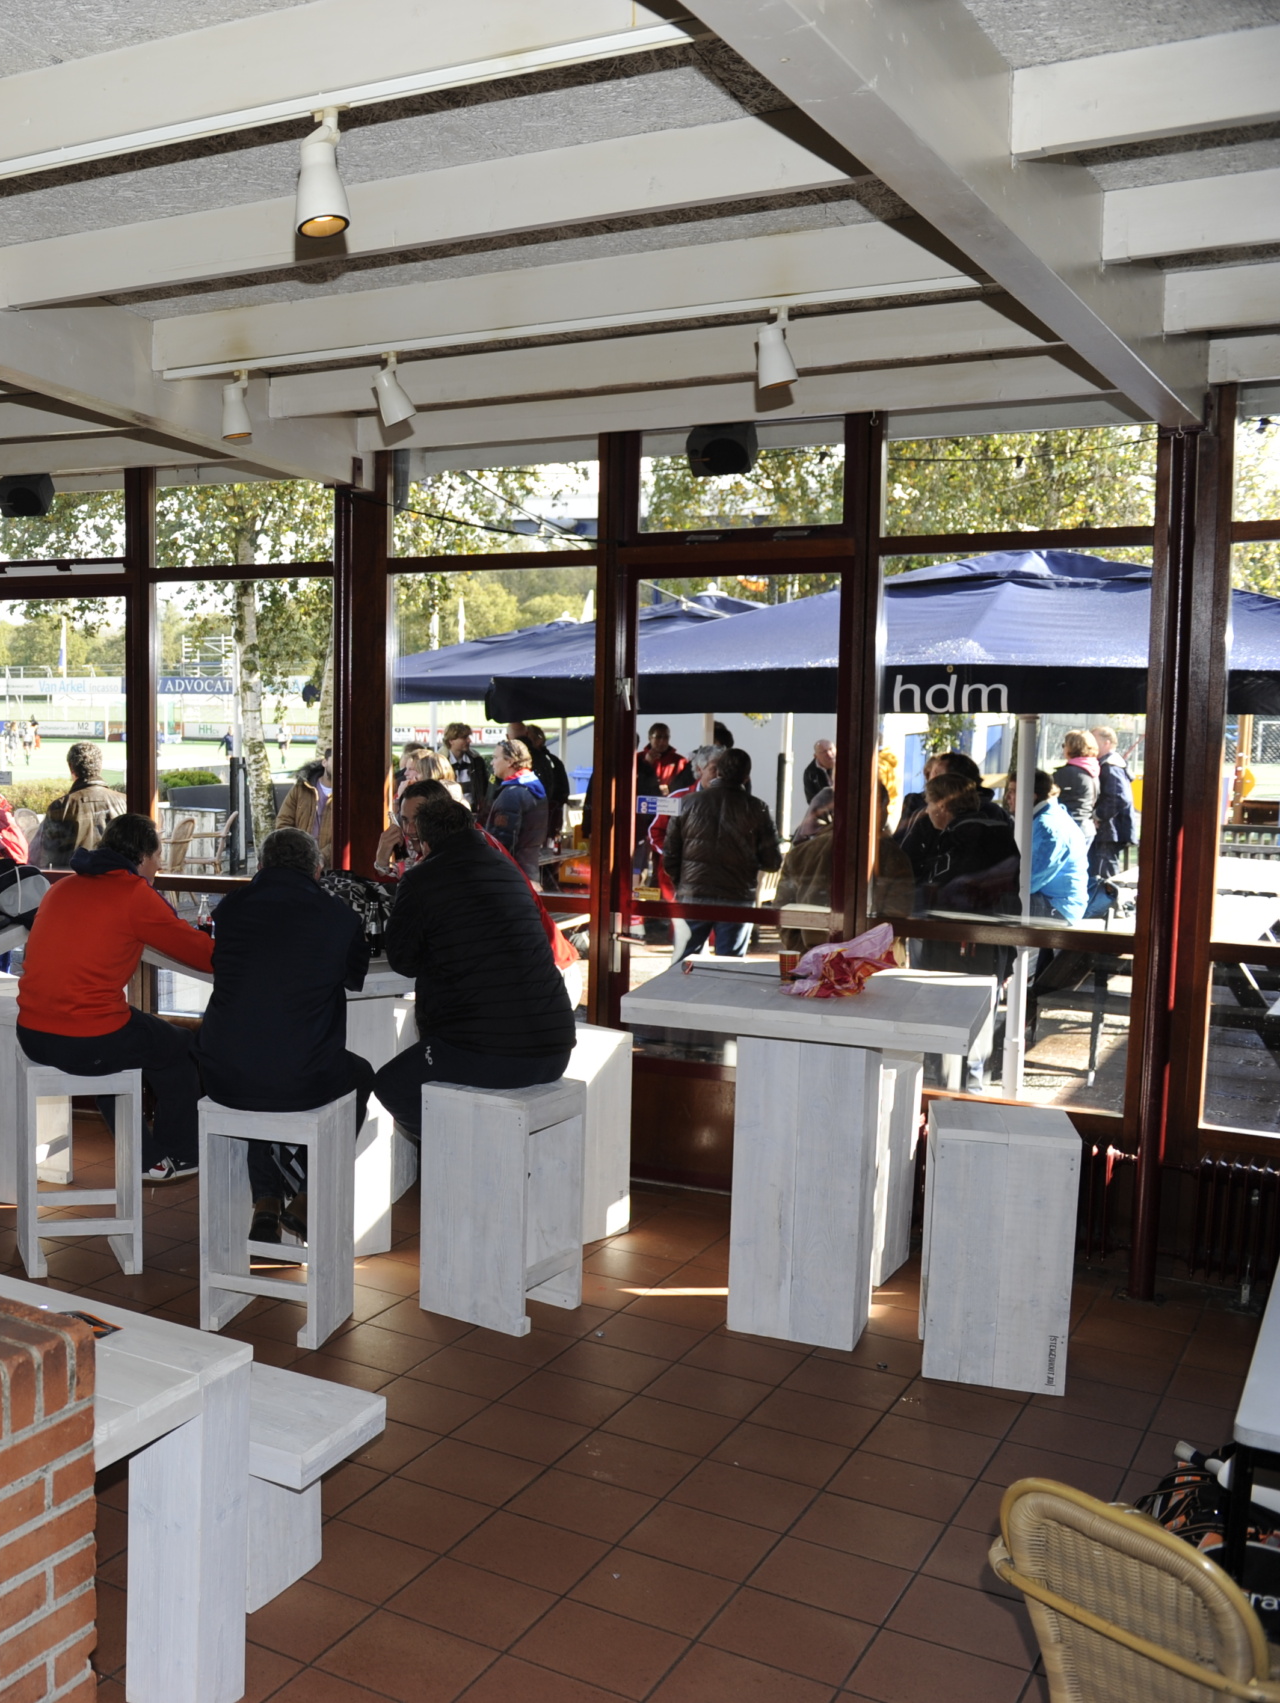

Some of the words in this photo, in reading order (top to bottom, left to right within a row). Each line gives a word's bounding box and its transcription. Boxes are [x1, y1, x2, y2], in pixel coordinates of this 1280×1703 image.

[39, 681, 57, 693] Van
[59, 681, 86, 693] Arkel
[165, 680, 233, 692] ADVOCAT
[893, 674, 1008, 713] hdm
[77, 722, 89, 730] M2
